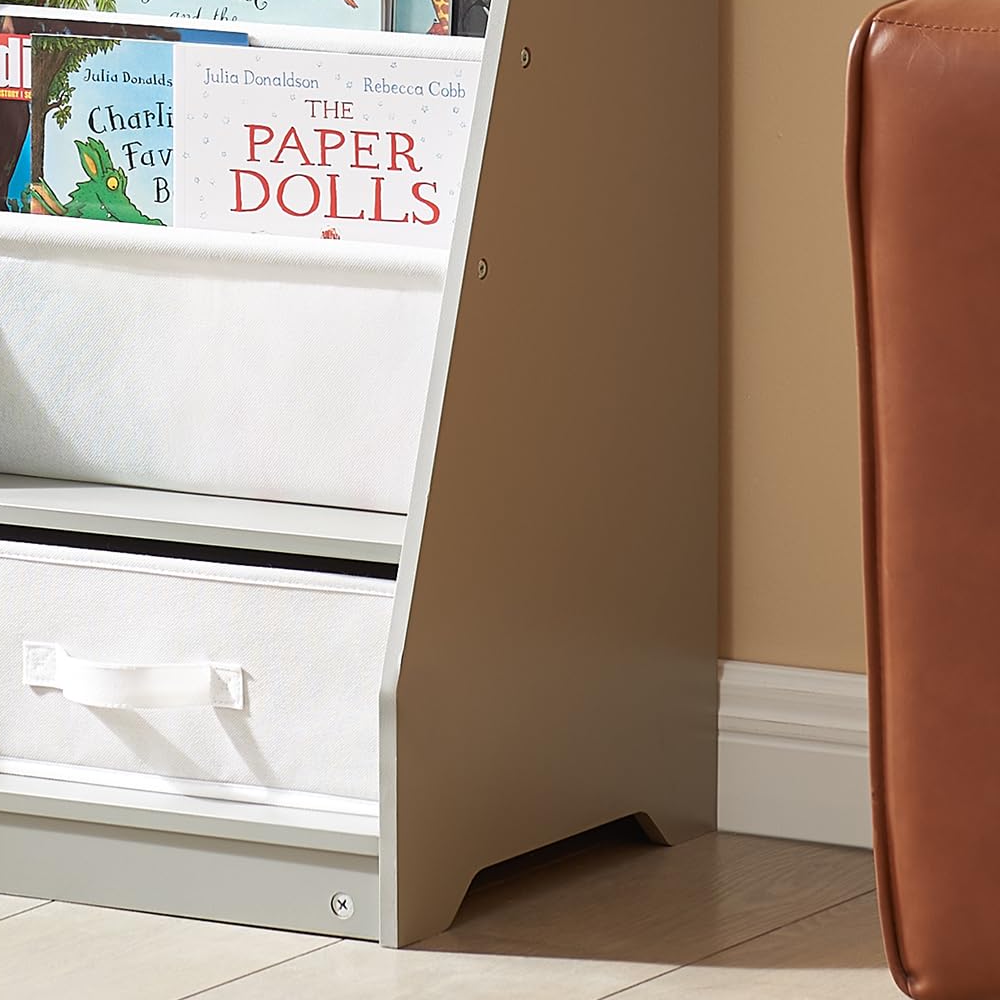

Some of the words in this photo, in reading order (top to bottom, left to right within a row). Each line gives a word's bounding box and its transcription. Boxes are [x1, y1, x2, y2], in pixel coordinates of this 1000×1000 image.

[83, 68, 118, 83] Julia
[122, 71, 173, 88] Donalds
[203, 67, 239, 87] Julia
[243, 69, 319, 90] Donaldson
[363, 77, 424, 96] Rebecca
[428, 81, 466, 99] Cobb
[88, 102, 174, 134] Charli
[304, 99, 354, 120] THE
[122, 140, 173, 172] Fav
[243, 123, 423, 172] PAPER
[229, 168, 441, 226] DOLLS
